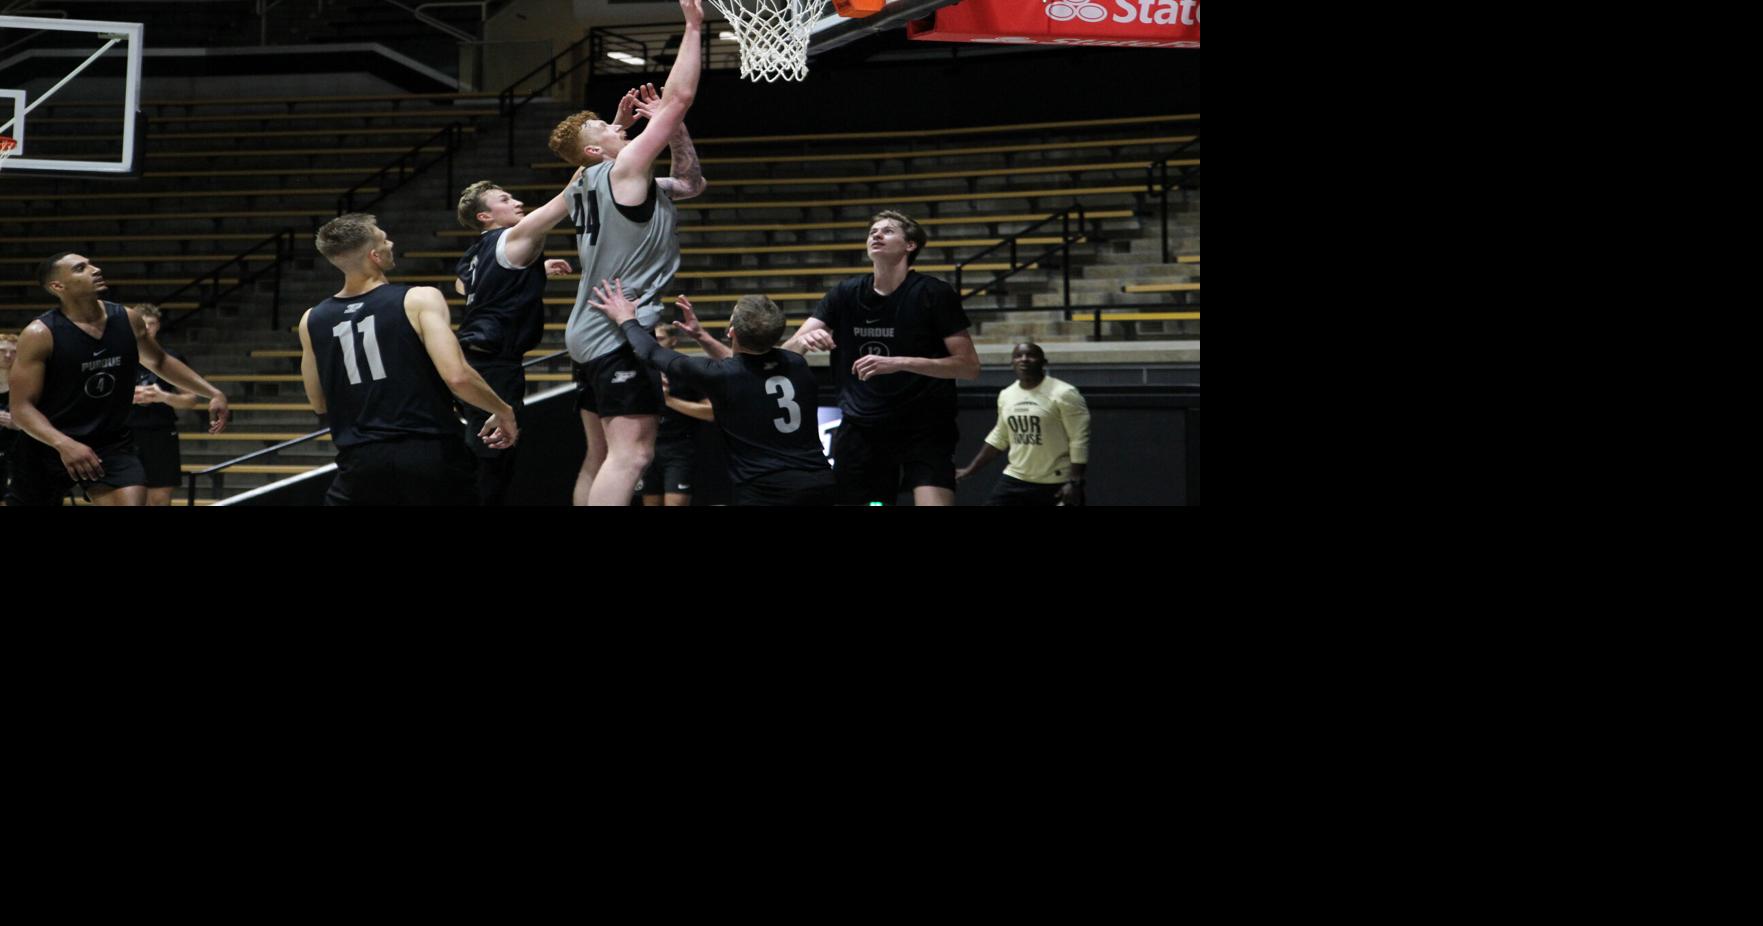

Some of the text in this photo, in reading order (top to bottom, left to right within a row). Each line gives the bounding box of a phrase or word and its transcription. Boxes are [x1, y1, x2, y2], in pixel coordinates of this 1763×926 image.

[1113, 0, 1199, 25] Stat
[573, 190, 600, 246] 44
[853, 327, 895, 337] PURDUE
[332, 315, 387, 386] 11
[81, 356, 122, 372] PURDUE
[765, 375, 801, 434] 3
[1008, 415, 1041, 433] OUR
